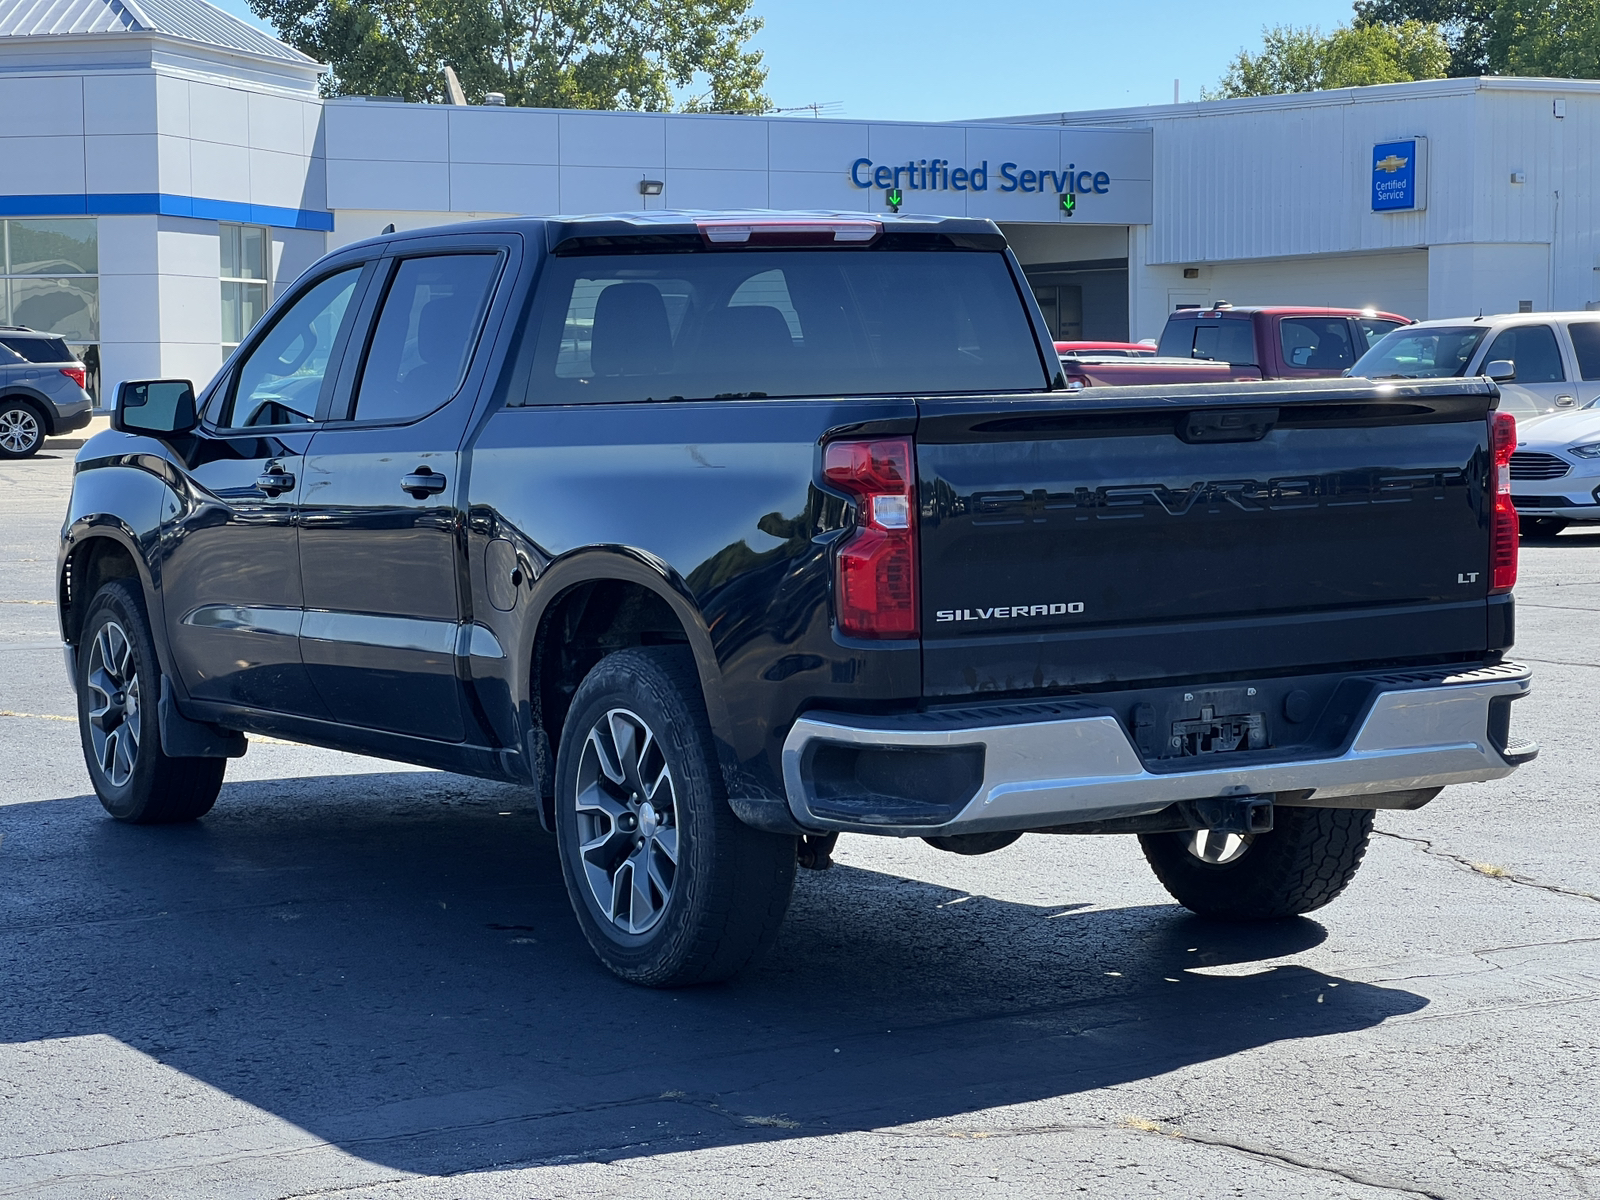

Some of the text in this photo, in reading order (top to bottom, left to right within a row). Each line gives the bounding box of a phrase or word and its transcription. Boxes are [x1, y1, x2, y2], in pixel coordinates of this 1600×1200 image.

[851, 158, 1111, 194] Certified Service
[1375, 179, 1407, 191] Certified
[1378, 190, 1404, 201] Service
[970, 467, 1462, 527] CHEVROLET
[1457, 572, 1480, 584] LT
[936, 601, 1085, 622] SILVERADO
